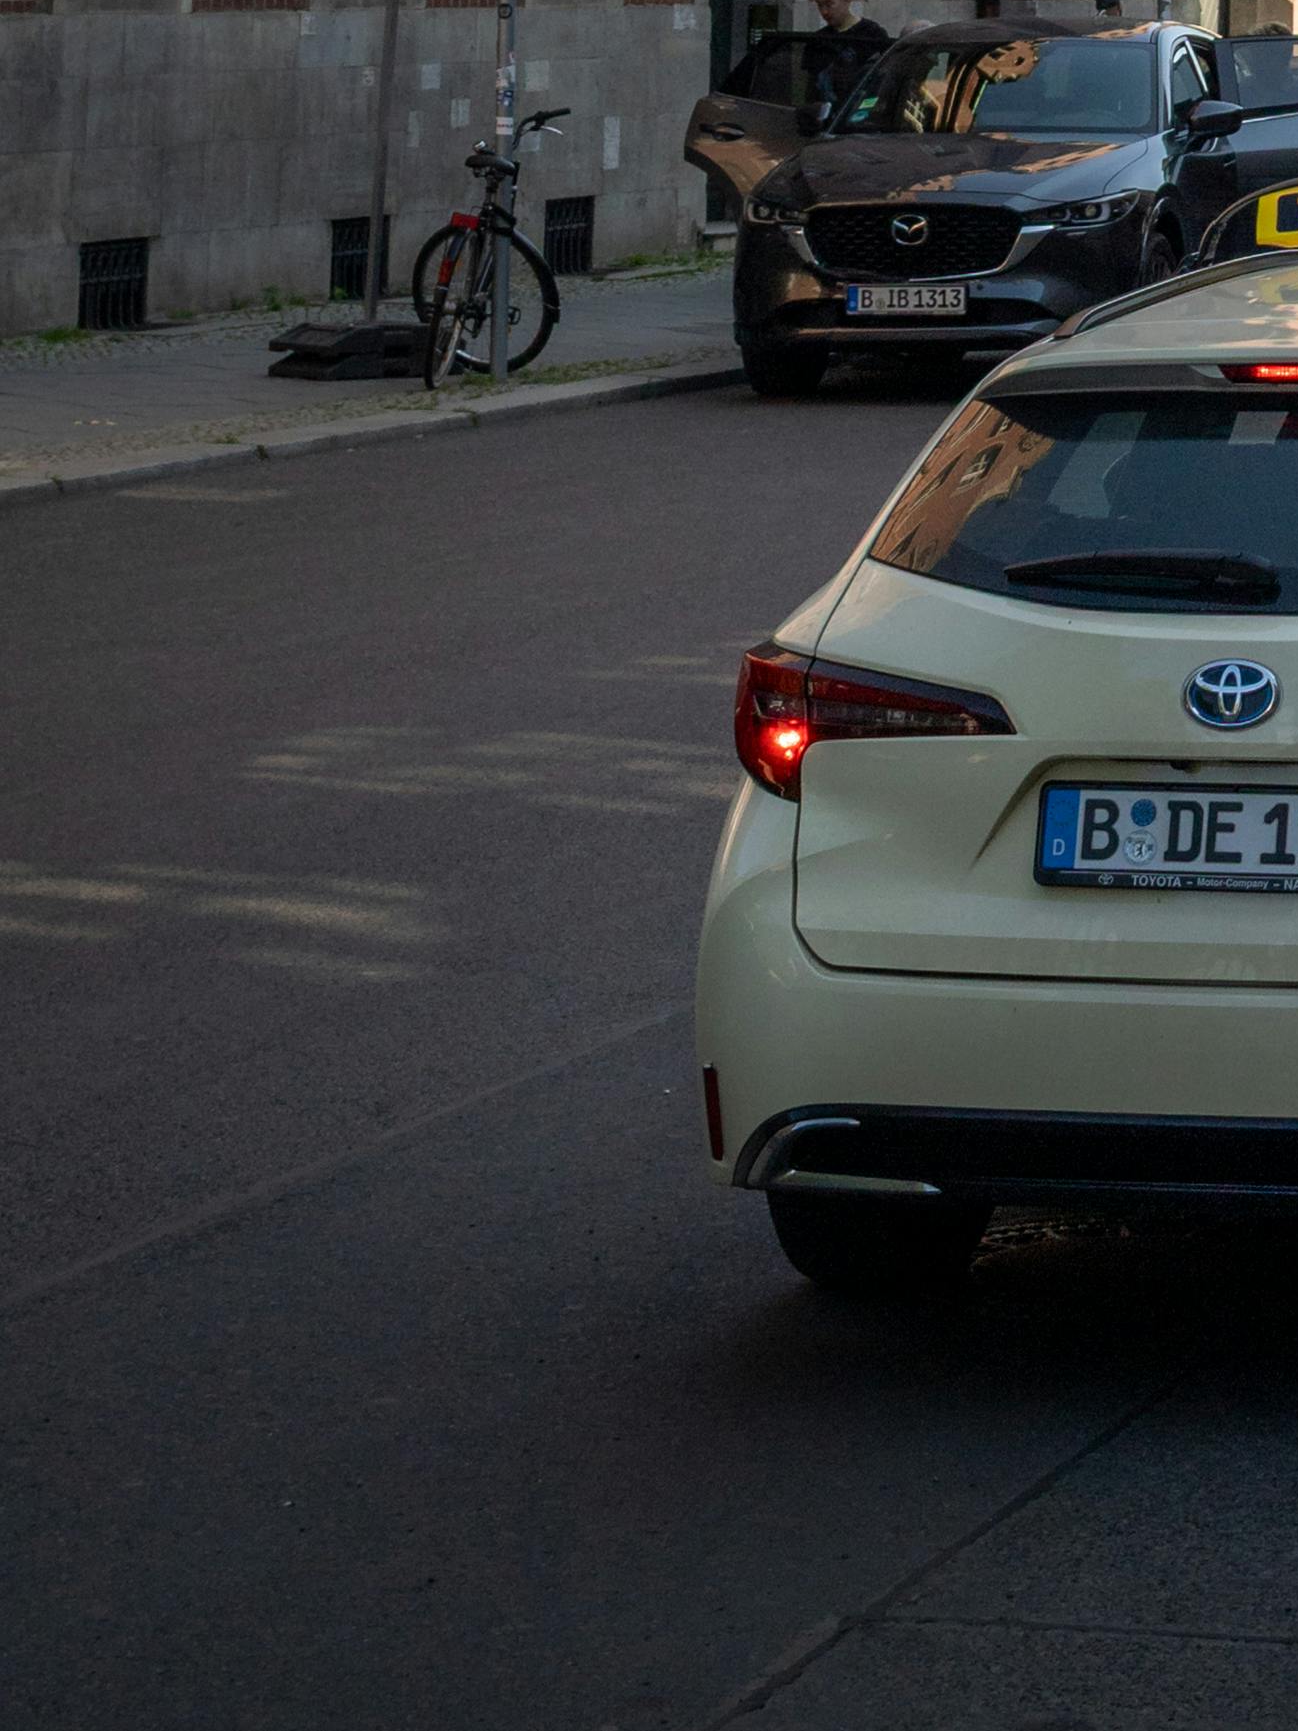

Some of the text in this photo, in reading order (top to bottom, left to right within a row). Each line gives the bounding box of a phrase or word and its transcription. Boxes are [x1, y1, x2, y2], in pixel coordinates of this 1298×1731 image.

[860, 289, 962, 308] B IB 1313
[1052, 838, 1066, 856] D
[1080, 798, 1121, 861] B
[1163, 799, 1245, 864] DE
[1132, 875, 1182, 888] TOYOTA
[1196, 876, 1269, 891] Motor-Company
